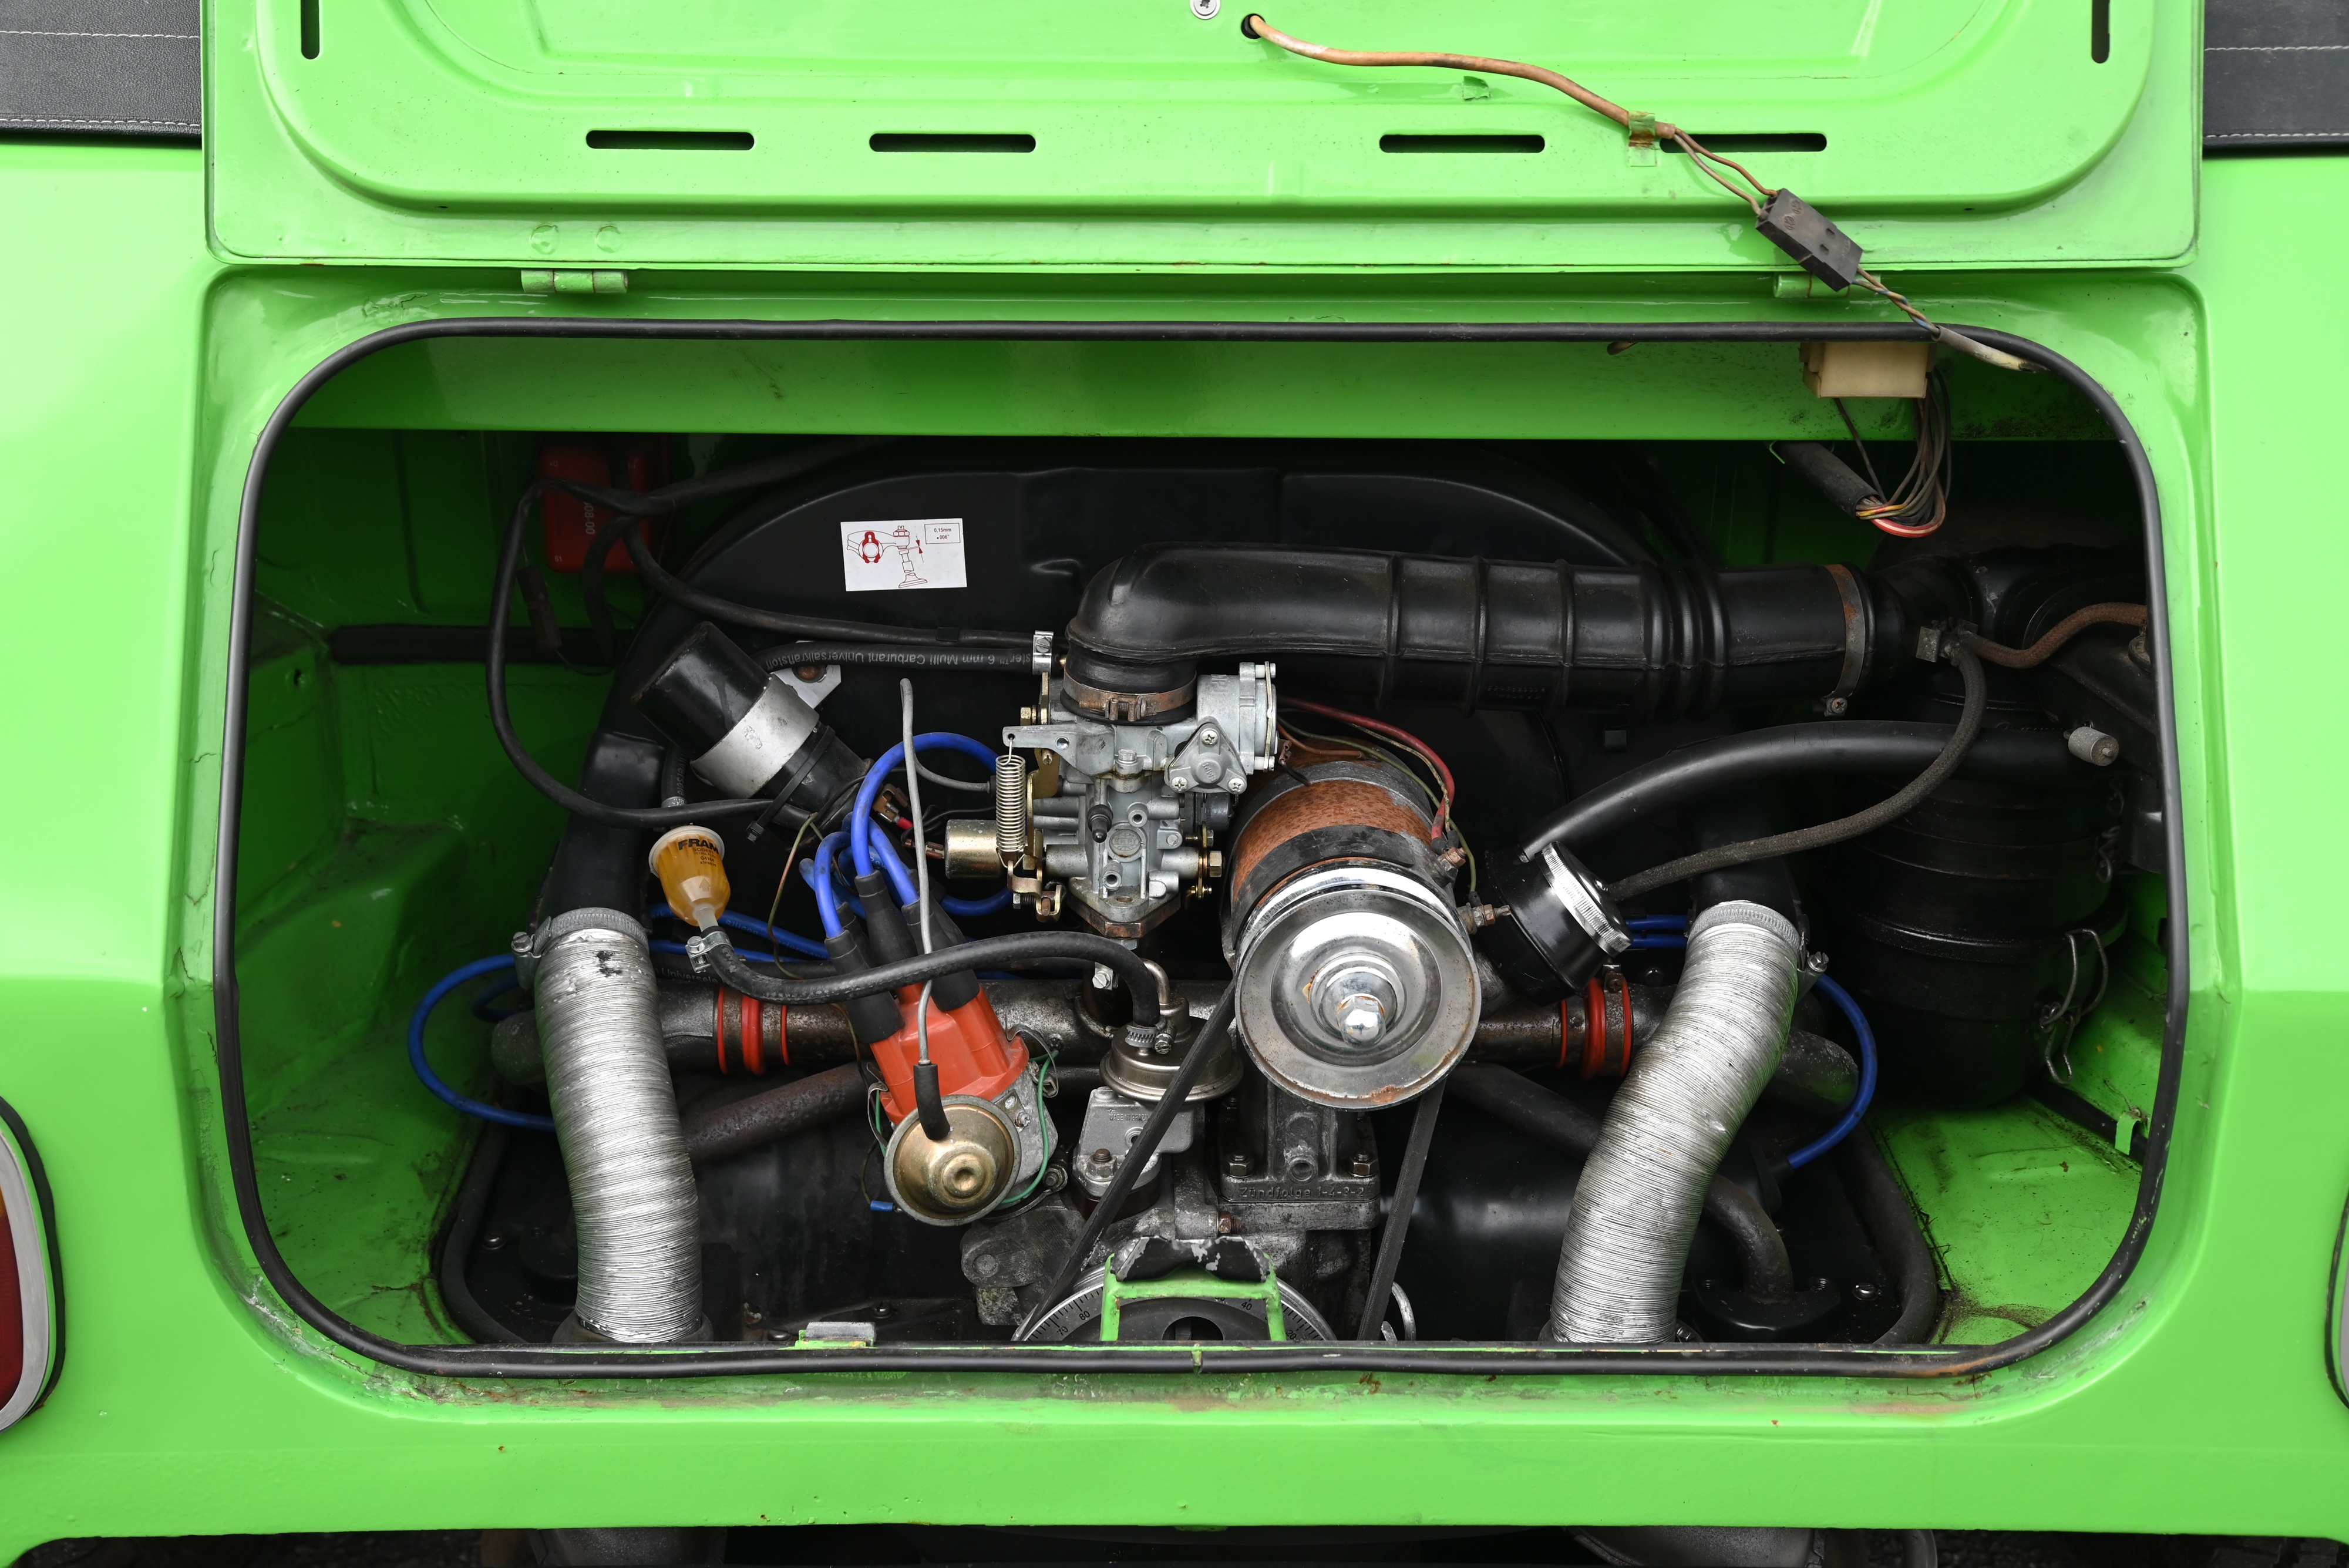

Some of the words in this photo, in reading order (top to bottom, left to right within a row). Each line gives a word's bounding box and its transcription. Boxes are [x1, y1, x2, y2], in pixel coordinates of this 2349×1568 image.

[868, 652, 926, 665] Carburant
[930, 654, 958, 665] Multi
[962, 654, 984, 664] mm
[988, 654, 995, 665] 6
[677, 753, 687, 796] niversele
[678, 838, 719, 854] FRAM
[1239, 1186, 1311, 1199] Zündfolge
[1317, 1186, 1364, 1197] 1-4-3-2
[1241, 1301, 1253, 1311] 40
[1079, 1310, 1091, 1321] 80
[1056, 1326, 1069, 1336] 70
[1286, 1329, 1297, 1340] 20
